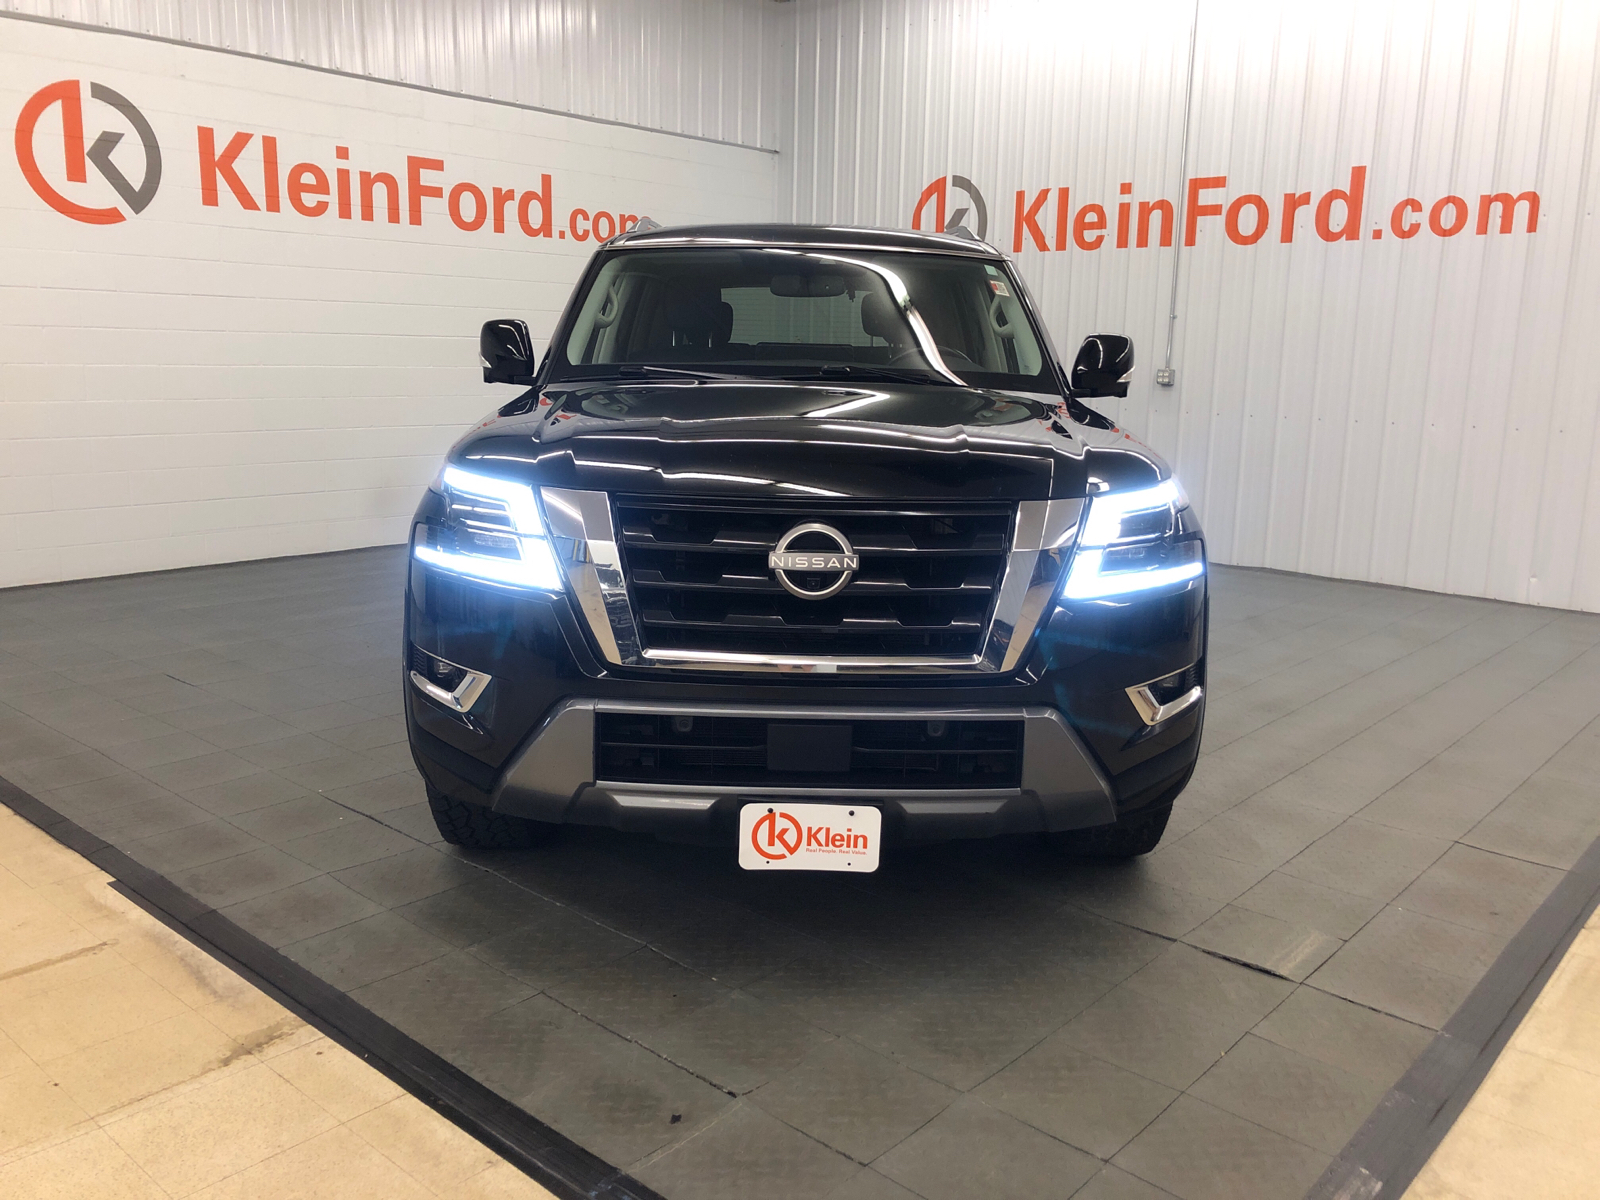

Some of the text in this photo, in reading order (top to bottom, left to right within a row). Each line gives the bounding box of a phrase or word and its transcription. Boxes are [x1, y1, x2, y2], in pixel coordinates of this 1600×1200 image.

[1012, 165, 1541, 254] KleinFord.com
[771, 555, 857, 569] NISSAN
[805, 826, 869, 850] Klein
